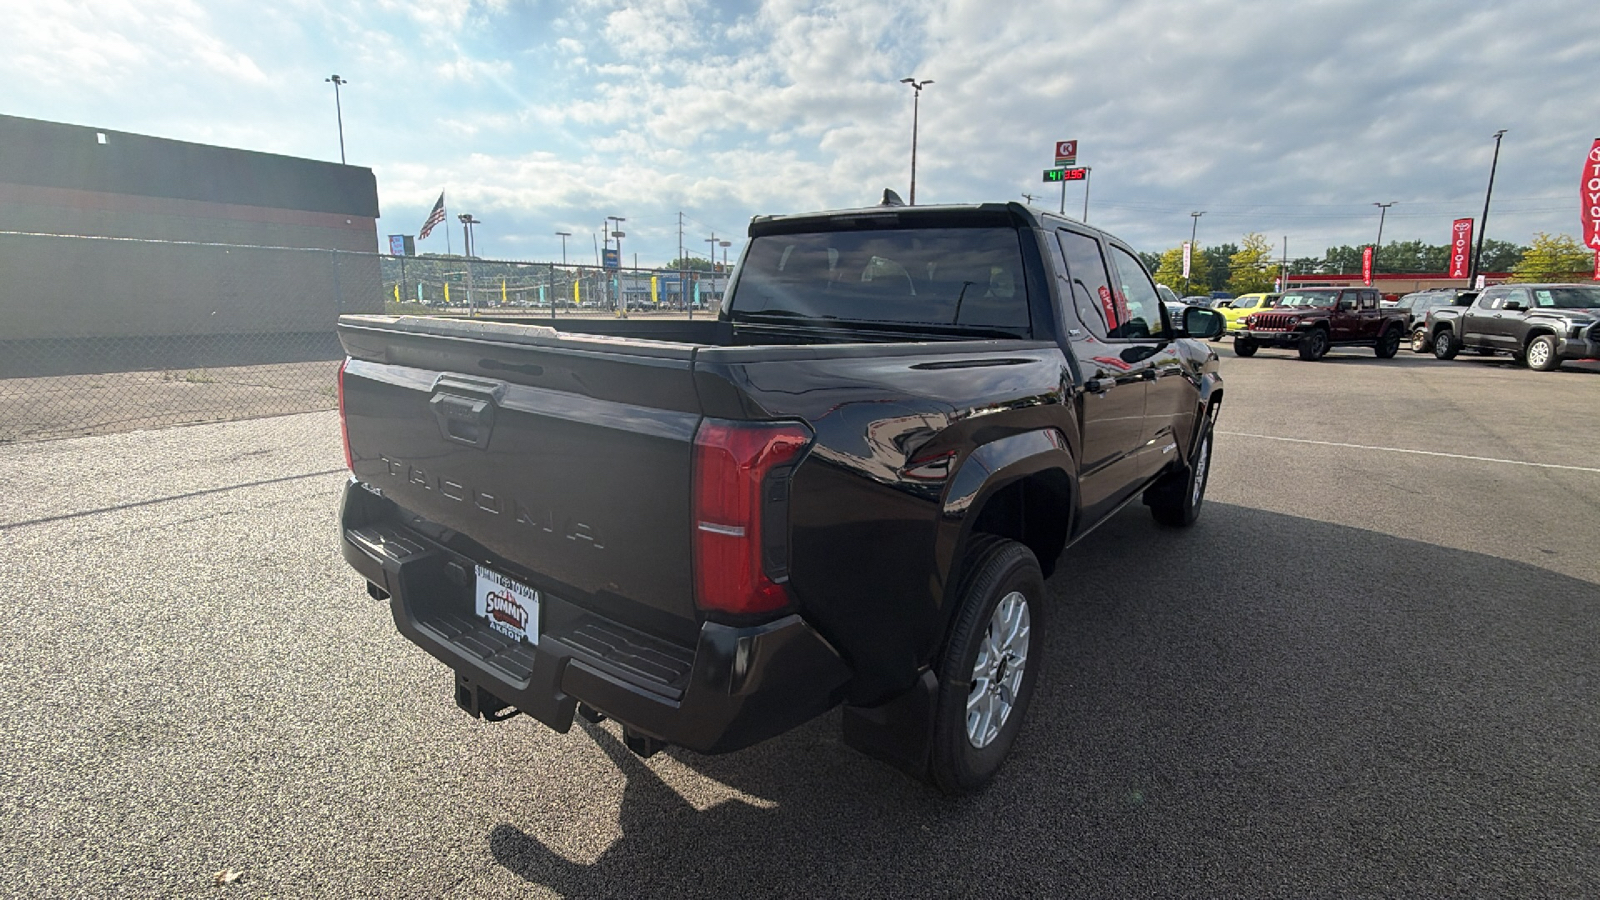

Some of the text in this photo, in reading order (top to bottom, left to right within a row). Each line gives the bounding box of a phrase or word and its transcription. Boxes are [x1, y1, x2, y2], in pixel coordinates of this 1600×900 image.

[1588, 164, 1600, 246] TOYOTA
[1454, 232, 1466, 276] TOYOTA
[379, 453, 604, 548] TACOMA
[475, 564, 539, 603] SUMMIT TOYOTA
[487, 593, 527, 628] SUMMIT
[489, 621, 521, 643] AKRON
